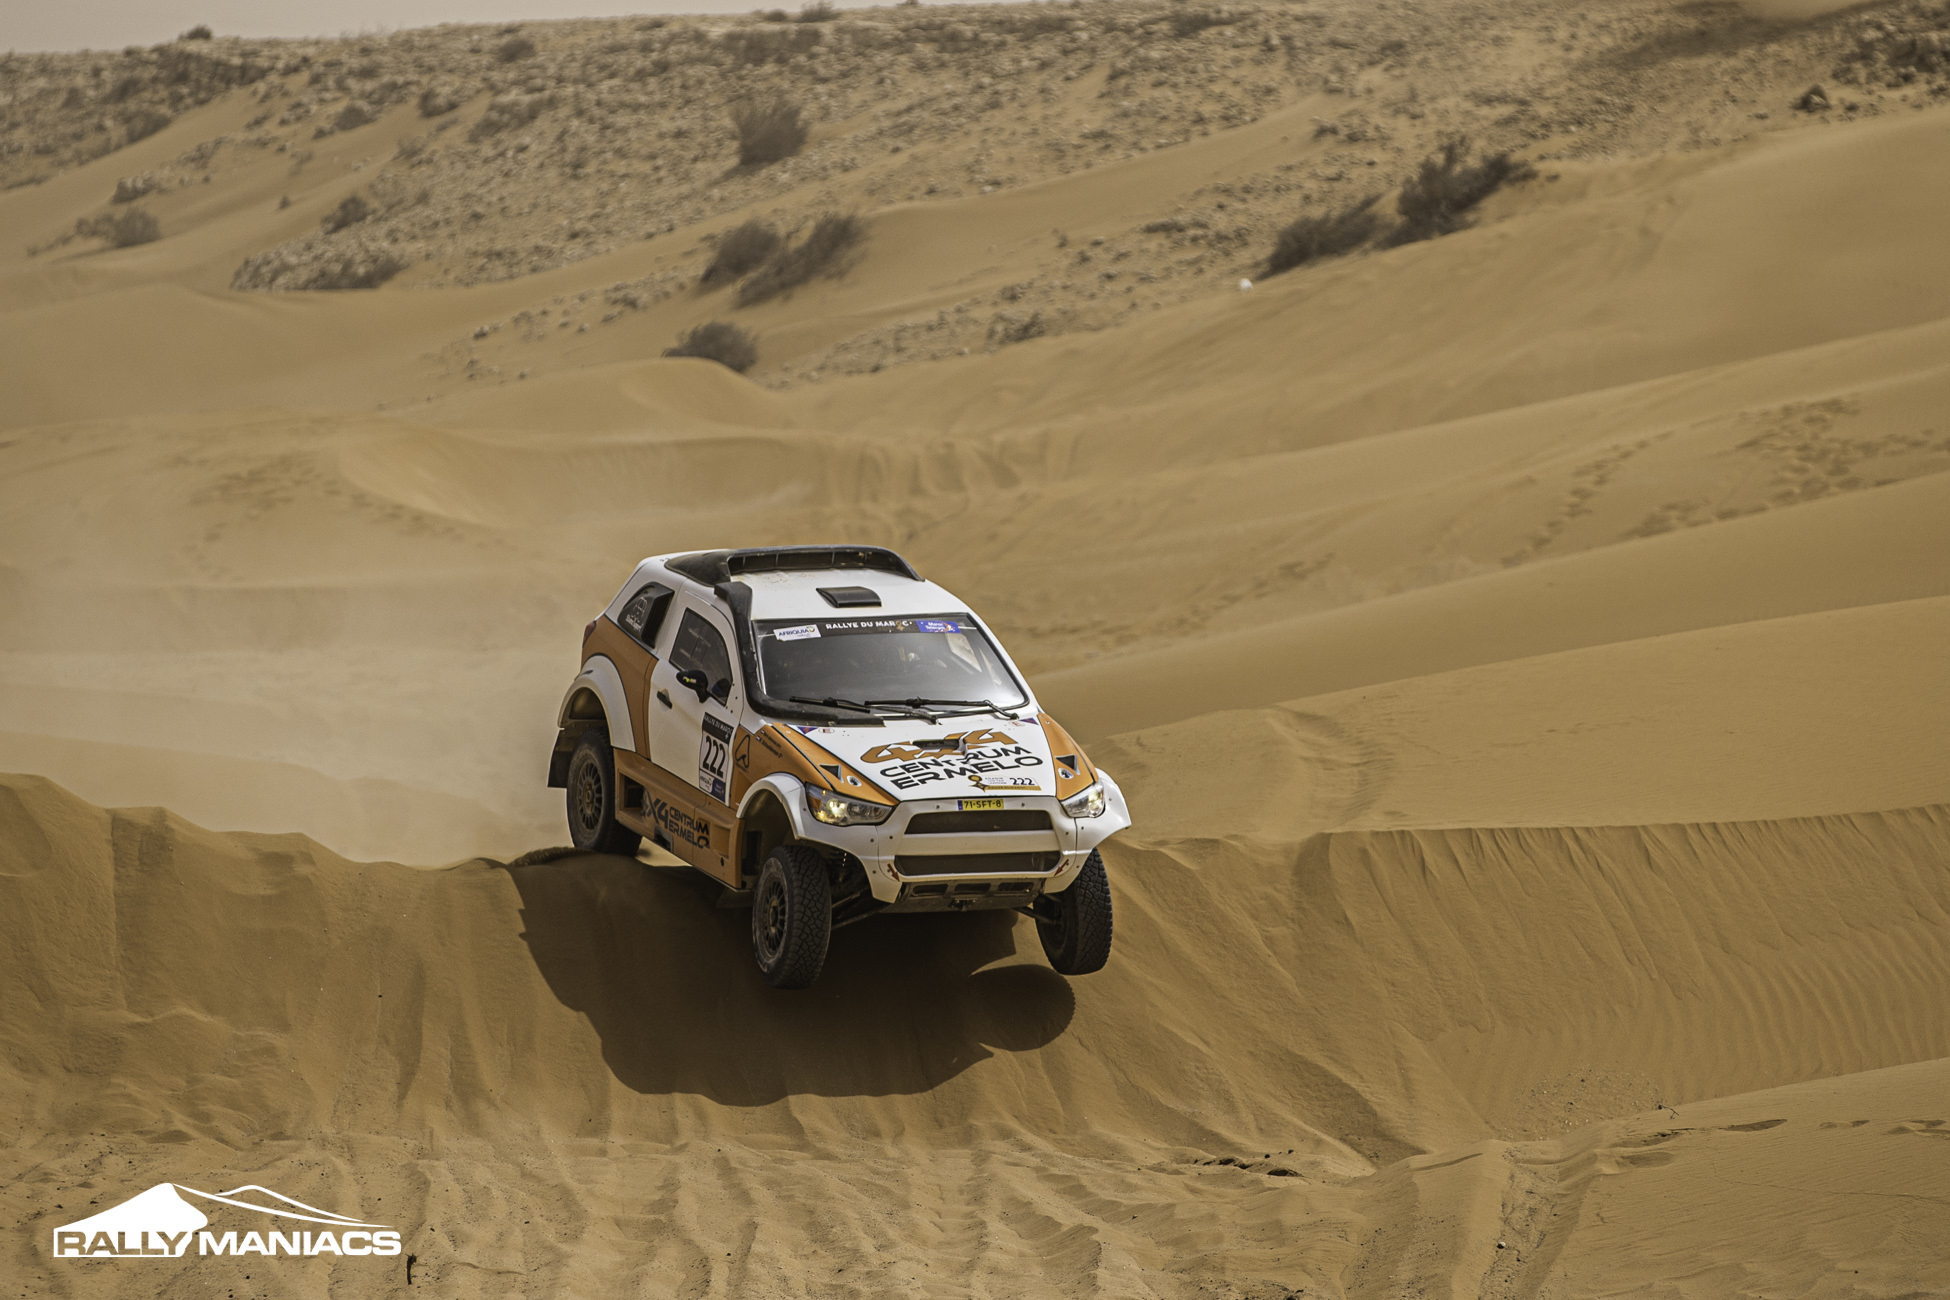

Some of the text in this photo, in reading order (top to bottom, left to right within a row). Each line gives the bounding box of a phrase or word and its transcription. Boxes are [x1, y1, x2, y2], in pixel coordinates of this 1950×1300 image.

[778, 628, 810, 637] AFRIQUIA
[825, 621, 859, 630] RALLYE
[860, 620, 874, 628] DU
[702, 735, 726, 778] 222
[880, 745, 1032, 777] CENTRUM
[890, 756, 1043, 790] ERMELO
[1009, 777, 1035, 786] 222
[963, 800, 1002, 809] 71-SFT-8
[668, 819, 710, 849] ERMELO
[669, 806, 710, 835] CENTRUM
